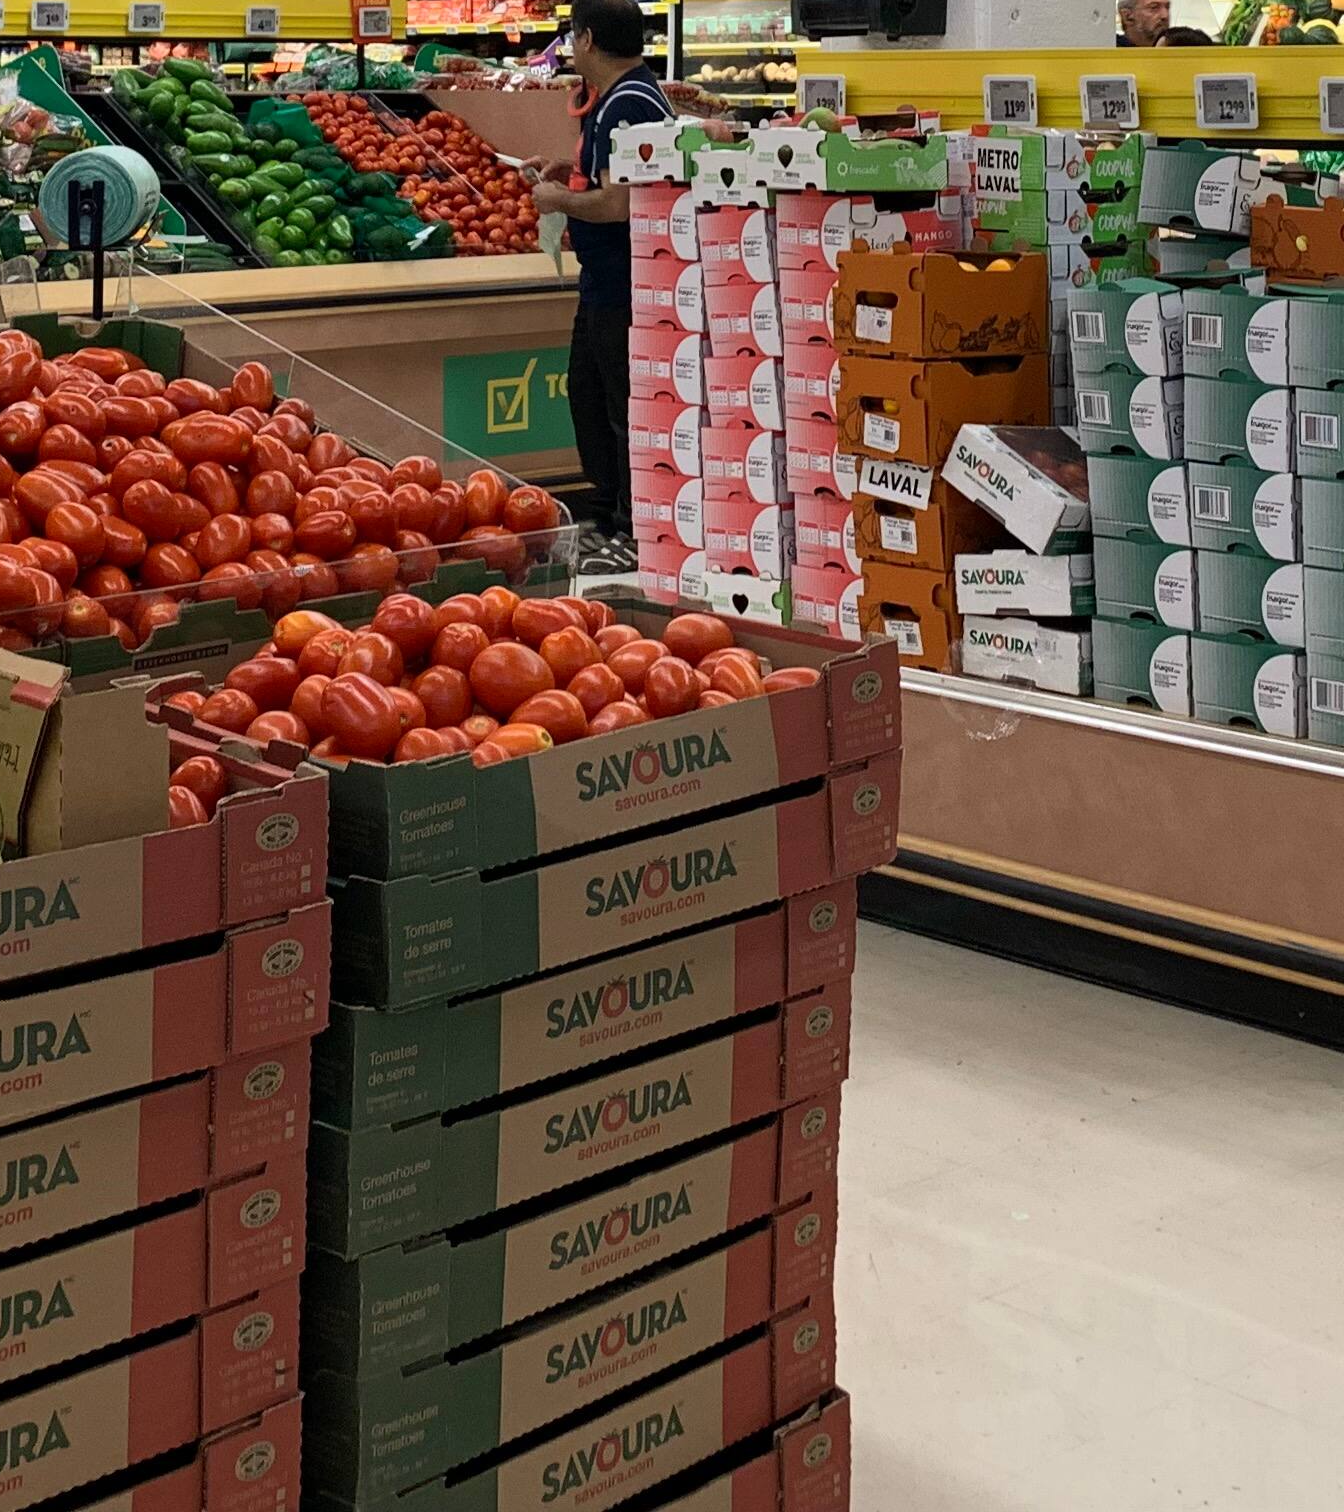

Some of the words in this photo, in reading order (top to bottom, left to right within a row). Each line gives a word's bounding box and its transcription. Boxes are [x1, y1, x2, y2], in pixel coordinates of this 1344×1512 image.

[977, 148, 1019, 171] METRO
[977, 173, 1019, 193] LAVAL
[915, 229, 953, 242] MANGO
[868, 465, 923, 499] LAVAL
[955, 445, 1016, 501] SAVOURA
[961, 569, 1025, 586] SAVOURA
[969, 629, 1034, 657] SAVOURA
[577, 727, 733, 803] SAVOURA
[614, 778, 702, 813] savoura.com
[585, 840, 739, 919] SAVOURA
[619, 890, 706, 927] savoura.com
[546, 960, 695, 1040] SAVOURA
[579, 1010, 663, 1048] savoura.com
[544, 1072, 693, 1154] SAVOURA
[577, 1121, 661, 1161] savoura.com
[549, 1184, 693, 1272] SAVOURA
[580, 1233, 661, 1277] savoura.com
[545, 1294, 688, 1385] SAVOURA
[541, 1405, 685, 1504] SAVOURA
